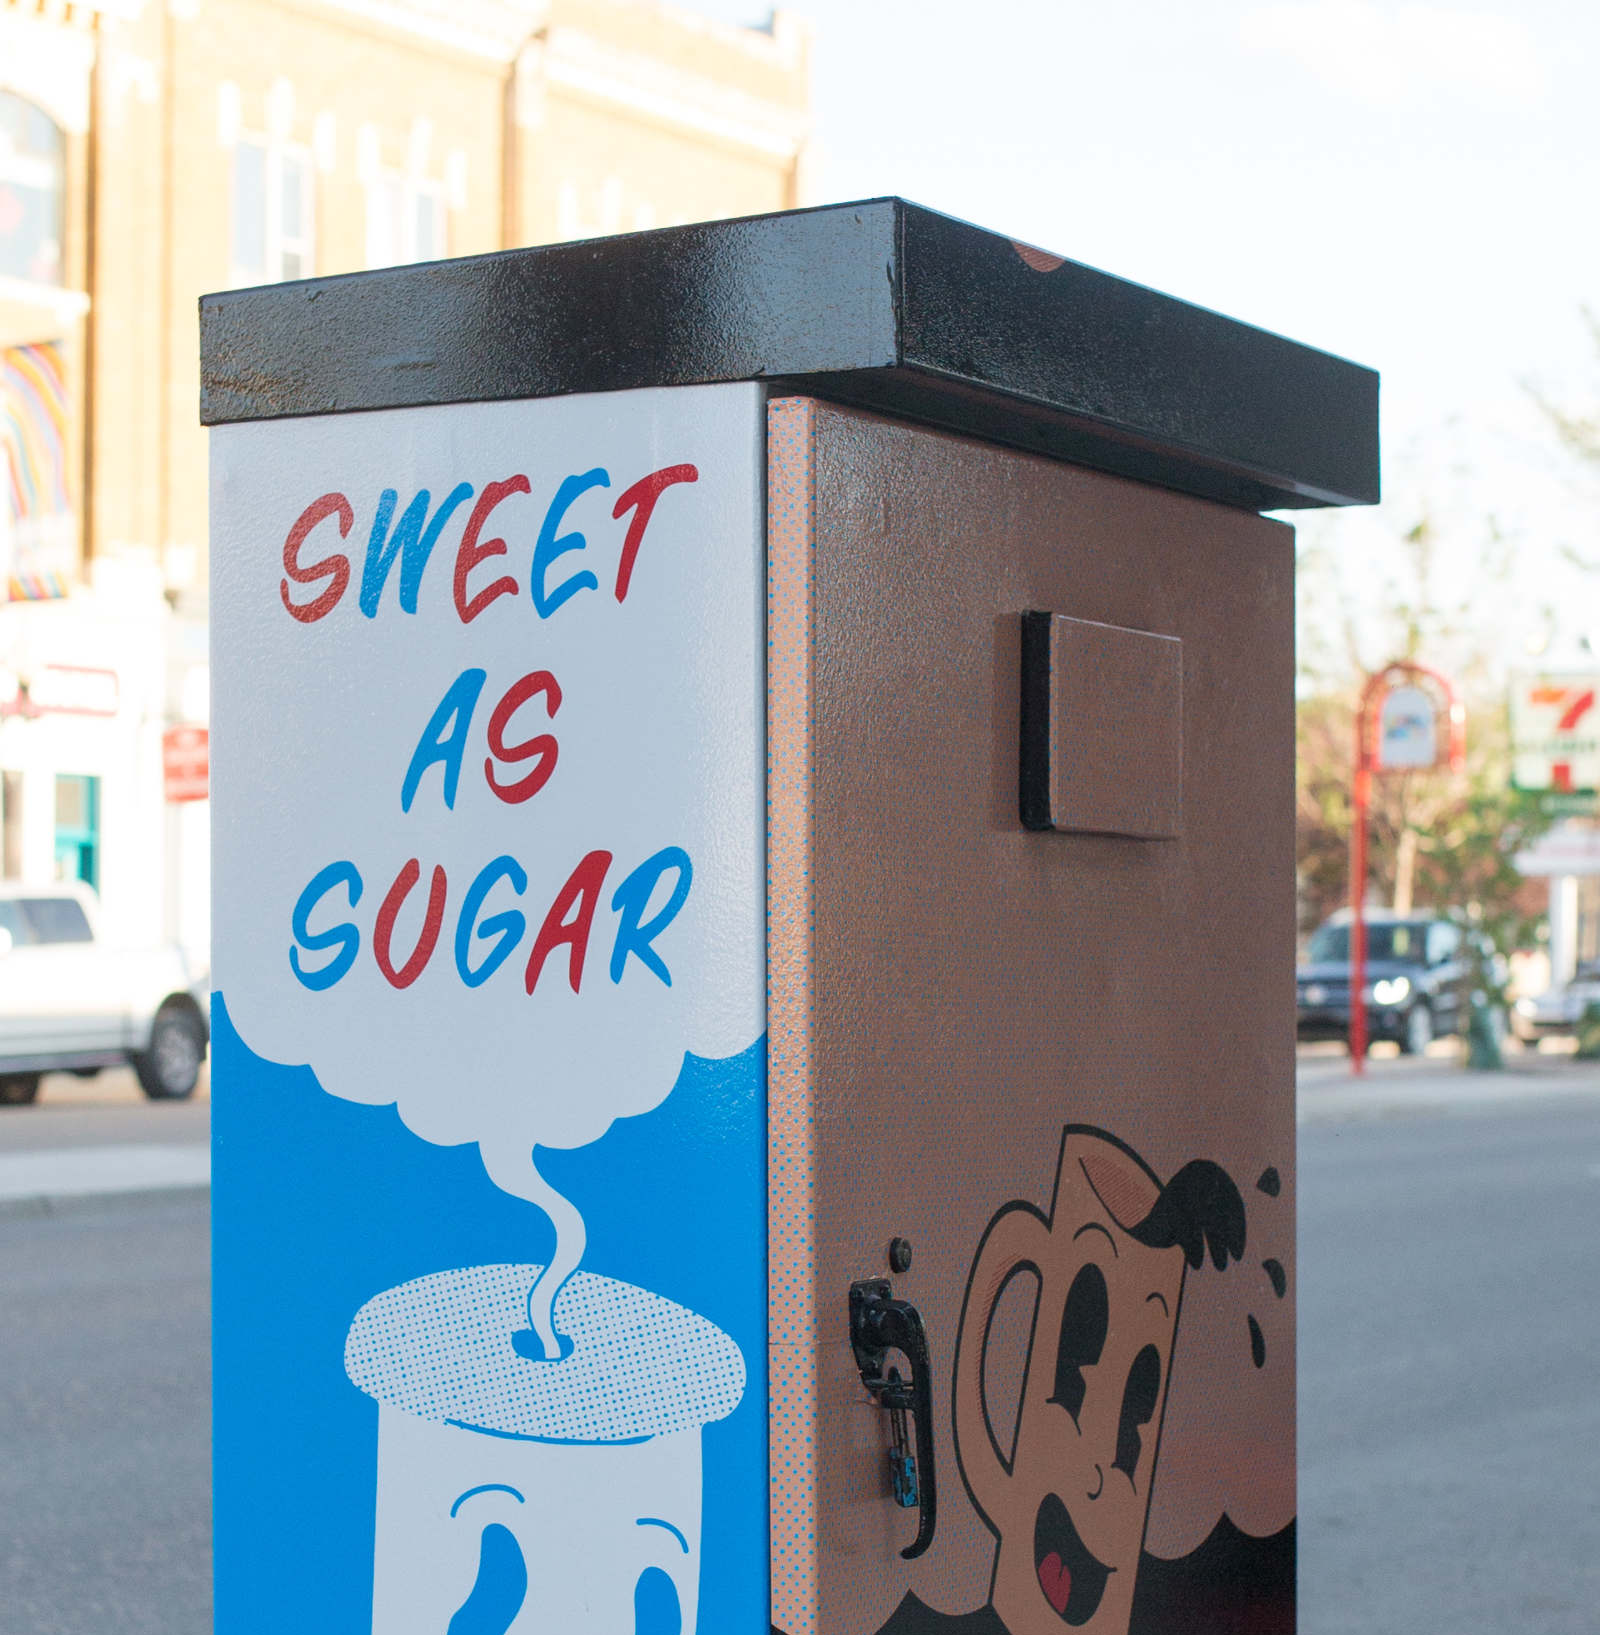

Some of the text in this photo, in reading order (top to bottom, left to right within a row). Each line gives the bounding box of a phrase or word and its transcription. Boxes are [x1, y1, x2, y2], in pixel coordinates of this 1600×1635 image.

[280, 463, 698, 624] SWEET
[400, 667, 563, 814] AS
[1530, 688, 1595, 793] 7
[288, 845, 694, 995] SUGAR
